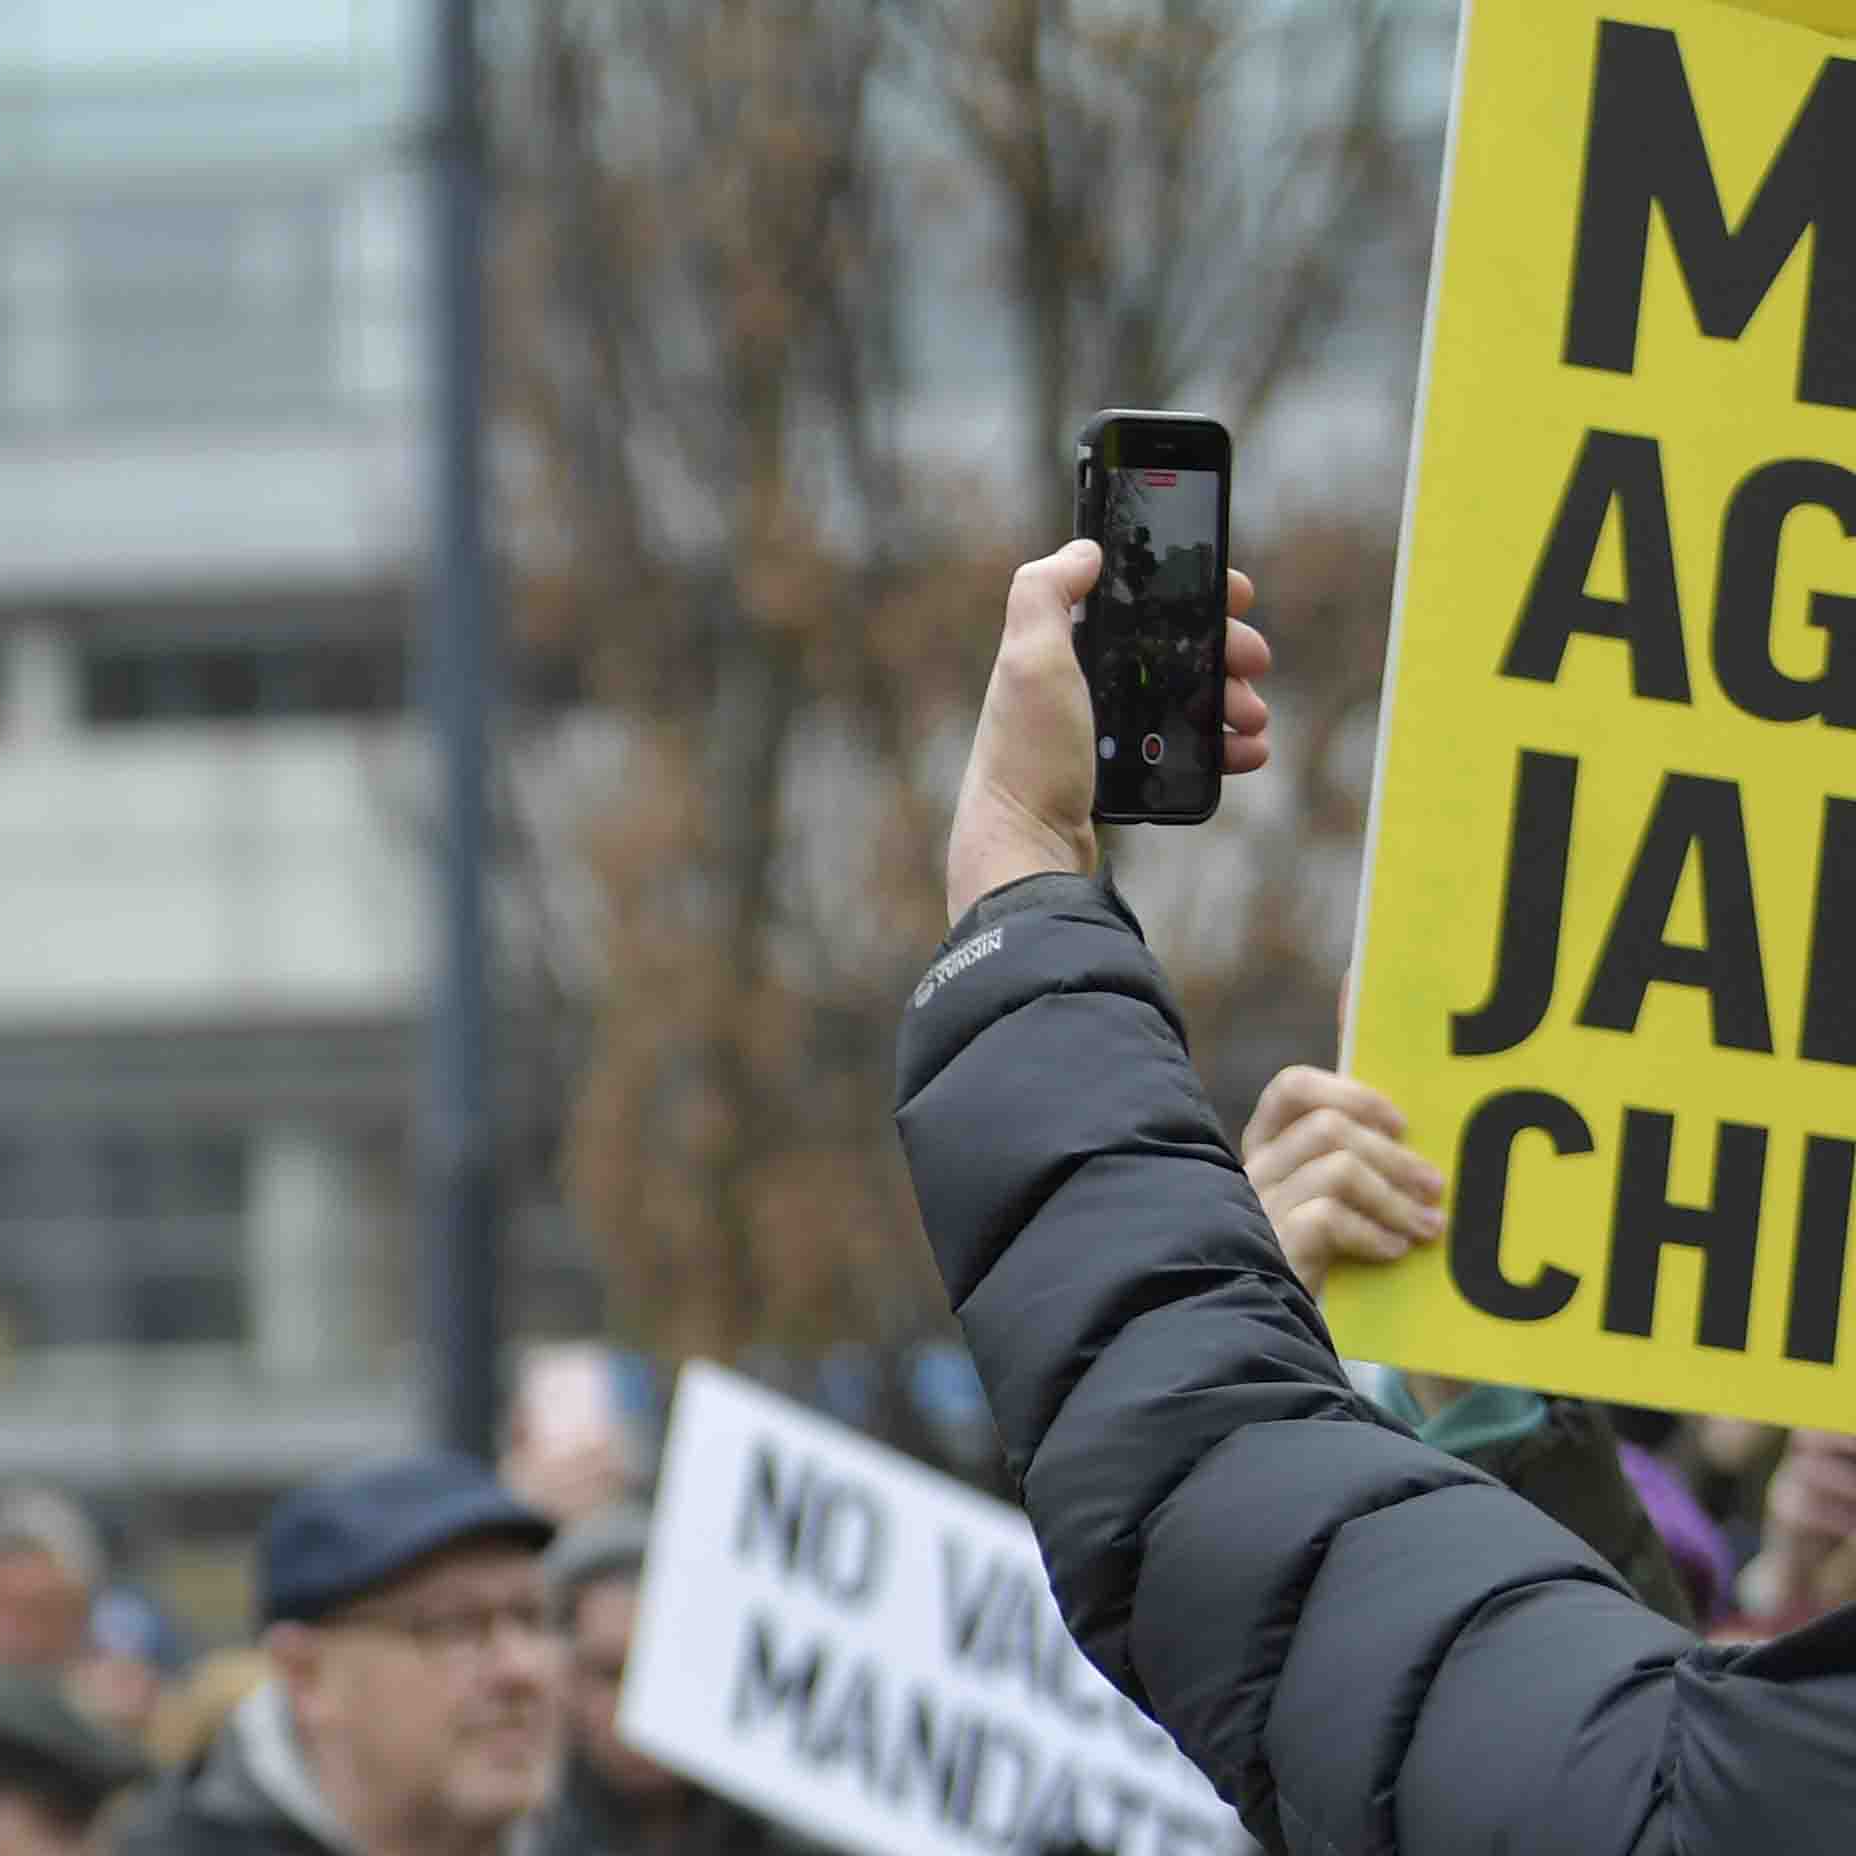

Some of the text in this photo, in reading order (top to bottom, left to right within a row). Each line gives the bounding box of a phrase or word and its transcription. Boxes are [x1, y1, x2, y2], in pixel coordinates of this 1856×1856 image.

[1560, 18, 1856, 412] M
[1497, 427, 1856, 729] AG
[734, 1433, 882, 1612] NO
